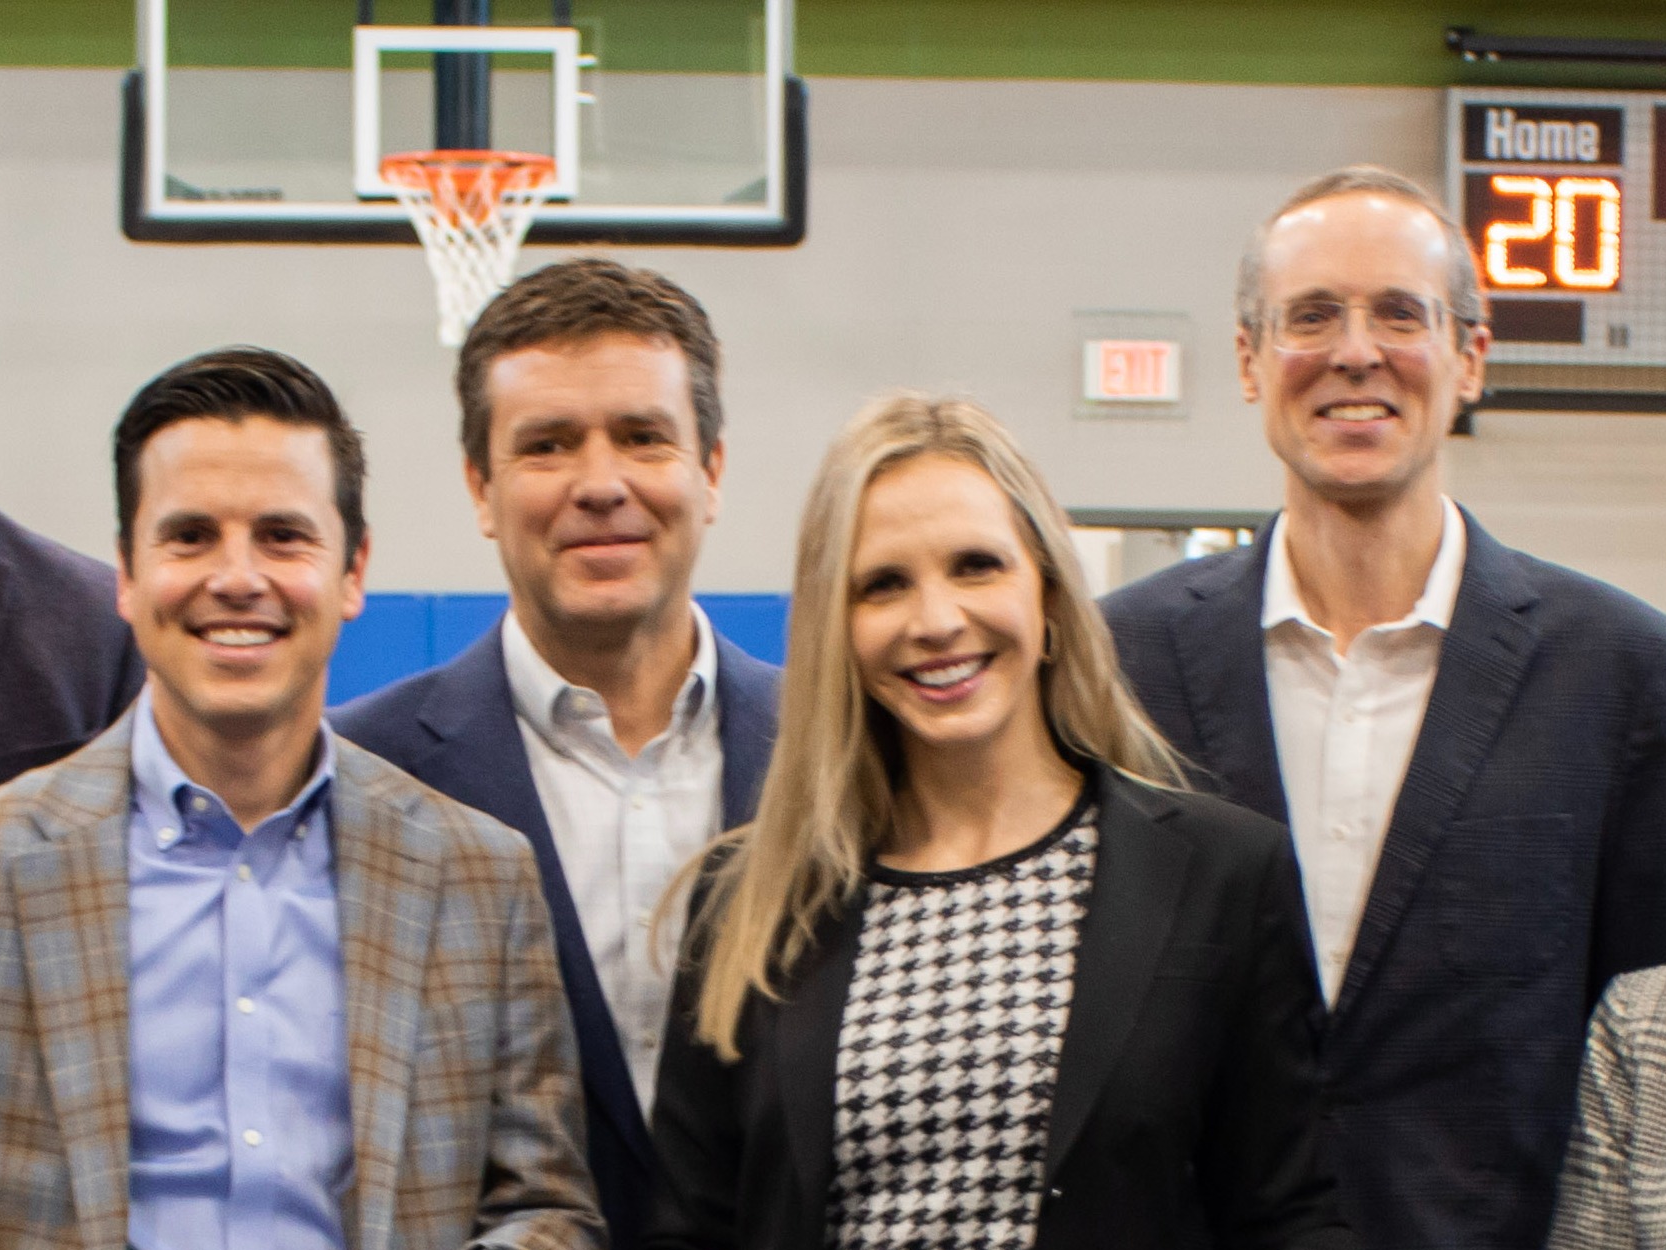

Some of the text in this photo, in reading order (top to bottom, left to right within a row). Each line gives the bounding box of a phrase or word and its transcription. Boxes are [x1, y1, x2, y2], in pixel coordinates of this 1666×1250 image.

[1486, 108, 1600, 161] Home
[1485, 175, 1621, 288] 20
[1102, 346, 1168, 395] EXIT
